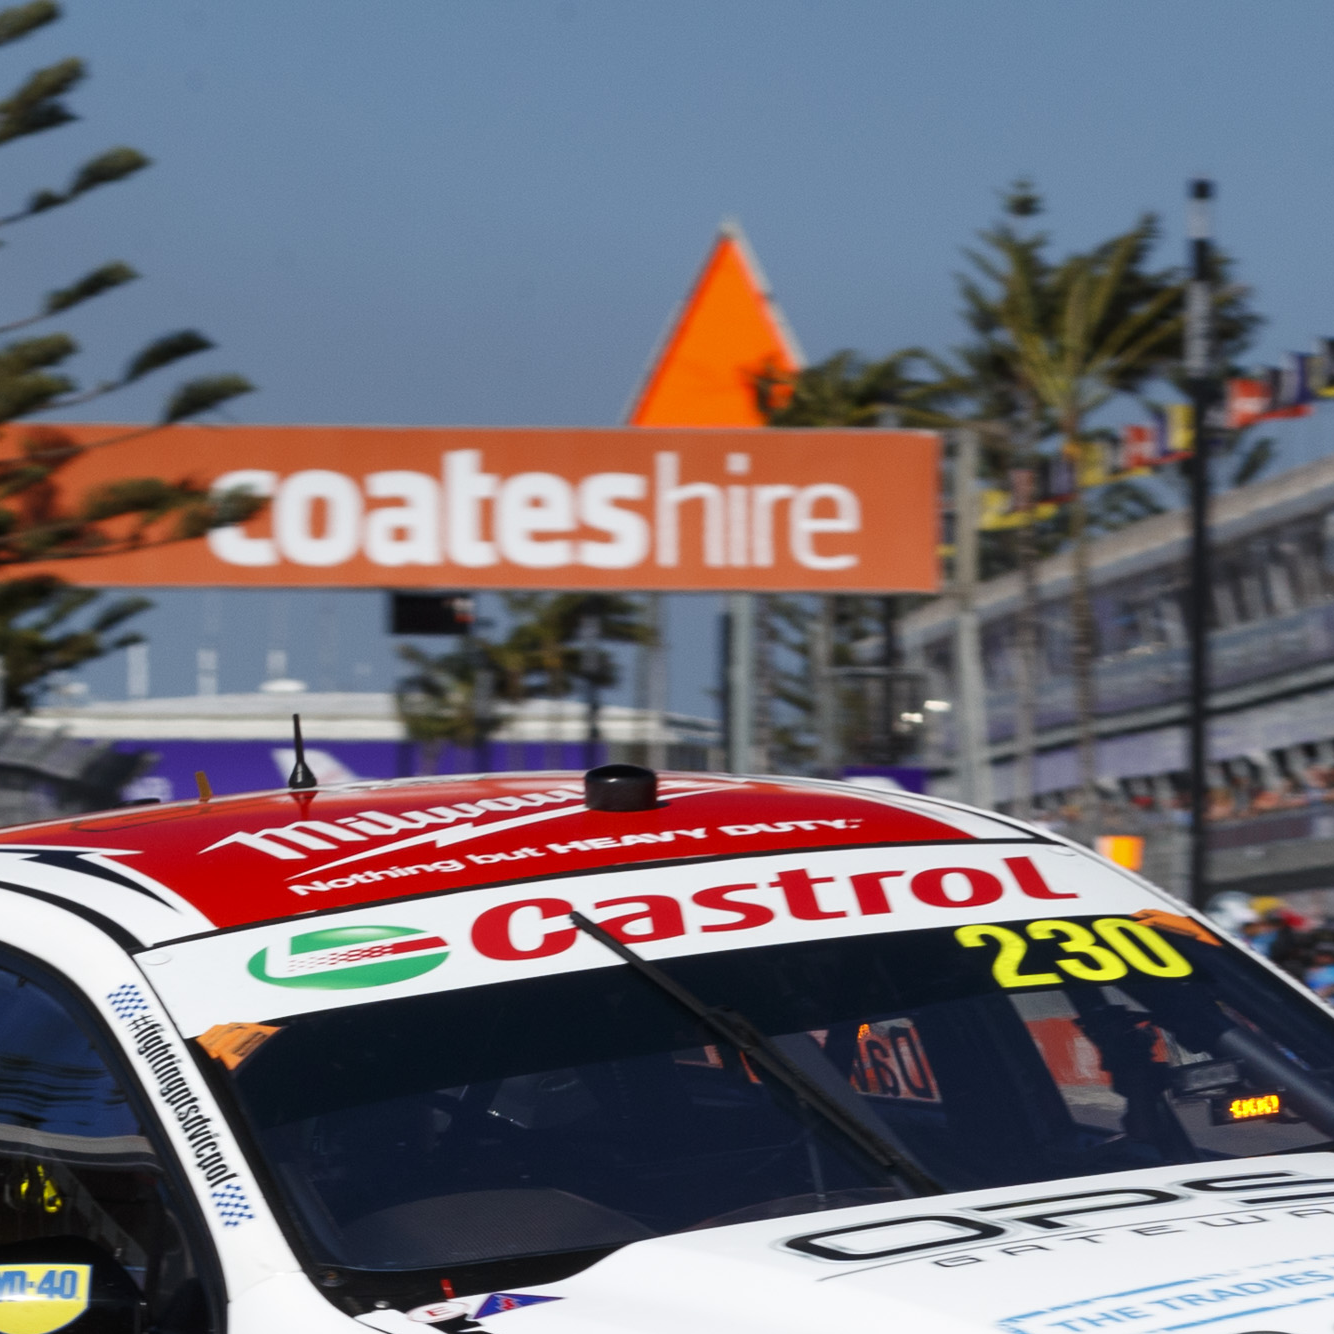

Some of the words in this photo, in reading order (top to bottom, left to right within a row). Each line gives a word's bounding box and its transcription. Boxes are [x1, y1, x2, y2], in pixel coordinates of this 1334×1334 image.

[287, 857, 464, 896] Nothing
[466, 844, 547, 866] but
[545, 828, 708, 855] HEAVY
[471, 857, 1080, 961] Castrol
[955, 917, 1194, 988] 230
[1160, 1268, 1334, 1314] TRADIES
